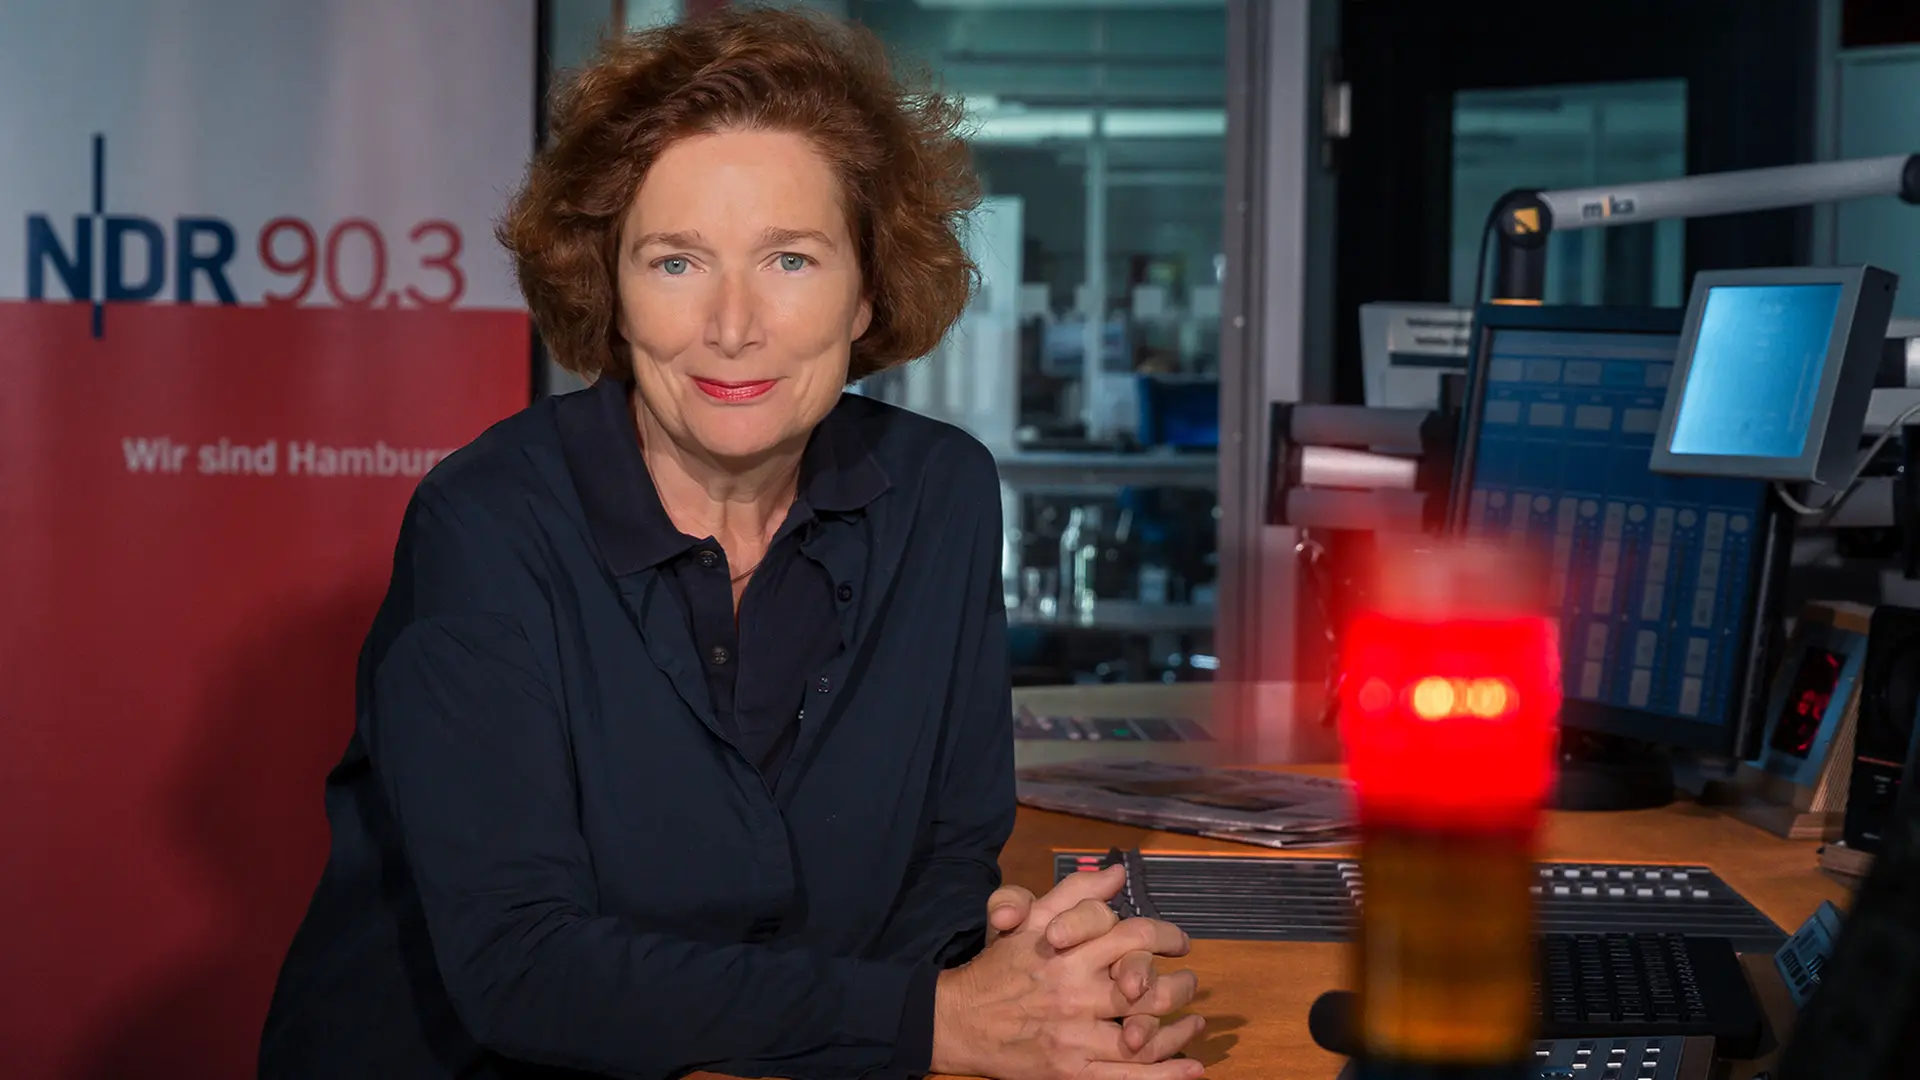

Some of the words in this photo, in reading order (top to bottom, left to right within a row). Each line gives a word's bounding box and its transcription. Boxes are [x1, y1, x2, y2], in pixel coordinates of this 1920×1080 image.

[25, 212, 239, 305] NDR
[257, 216, 467, 309] 90.3
[121, 436, 188, 474] Wir
[197, 437, 279, 475] sind
[286, 439, 458, 477] Hambur
